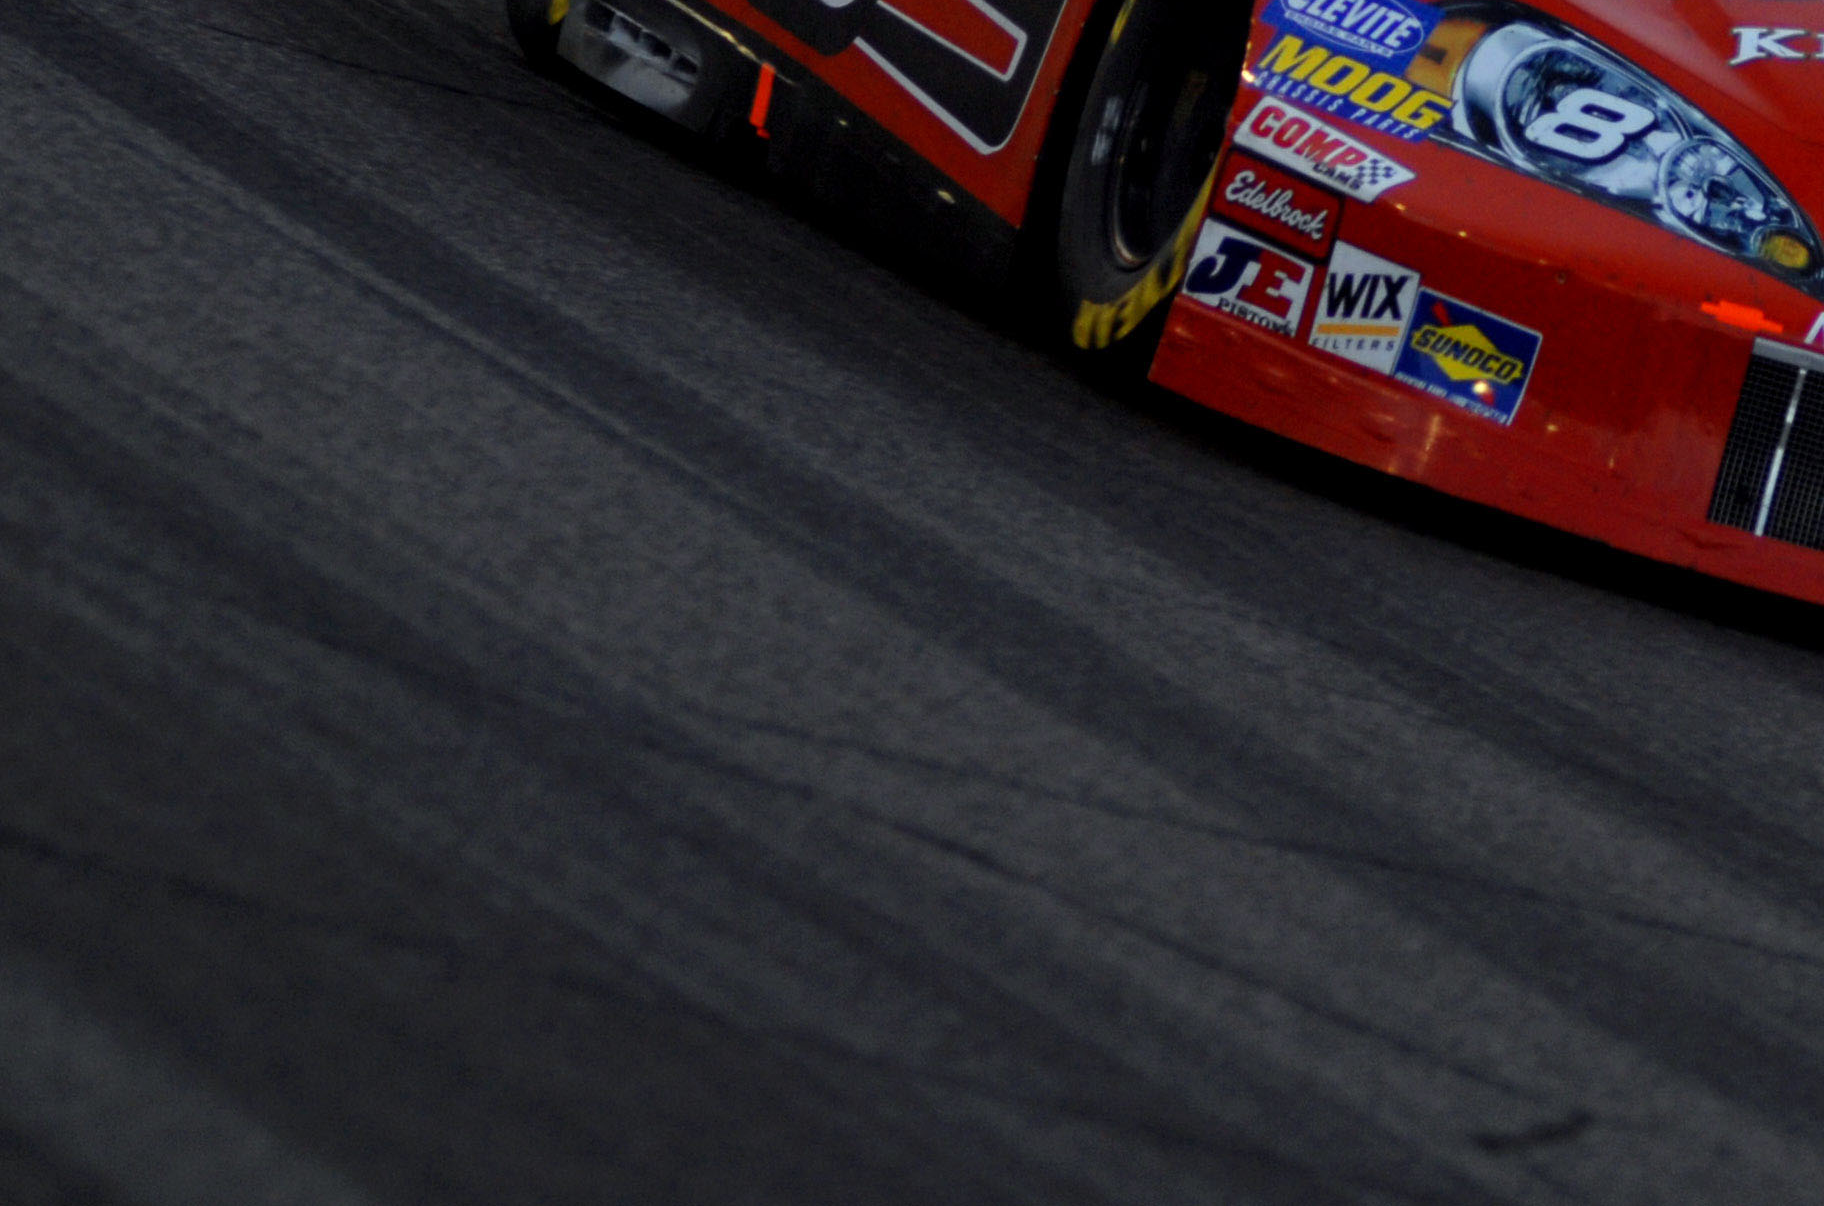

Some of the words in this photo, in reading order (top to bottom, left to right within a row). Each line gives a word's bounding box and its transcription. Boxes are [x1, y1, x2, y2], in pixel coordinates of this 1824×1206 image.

[1253, 71, 1345, 113] CHASSIS
[1349, 107, 1421, 140] PARTS
[1258, 34, 1453, 130] MOOG
[1250, 105, 1369, 169] COMP
[1525, 87, 1656, 162] 8
[1225, 170, 1329, 241] Edelbrock
[1184, 235, 1306, 320] JE
[1325, 272, 1414, 321] WIX
[1309, 337, 1396, 352] FILTERS
[1414, 328, 1519, 381] SUNOCO
